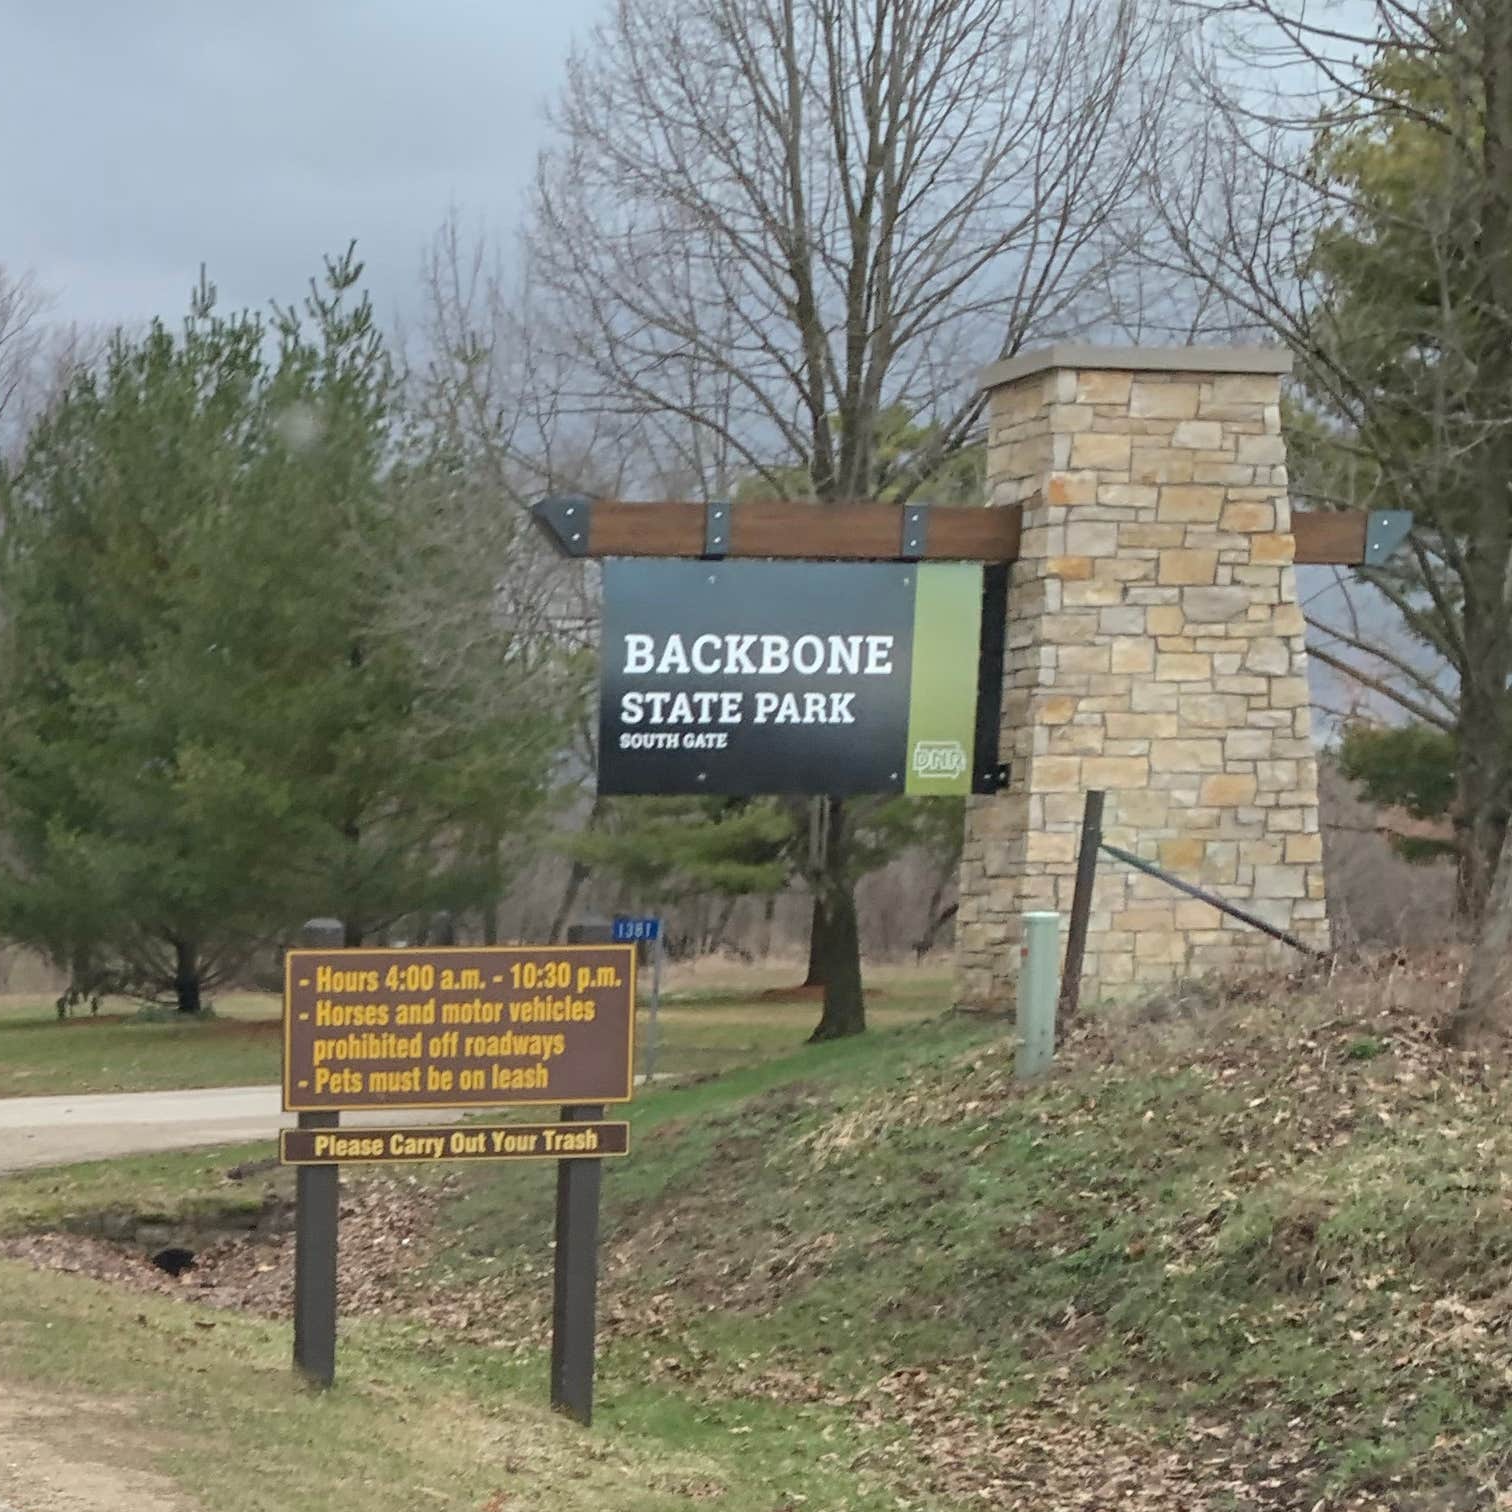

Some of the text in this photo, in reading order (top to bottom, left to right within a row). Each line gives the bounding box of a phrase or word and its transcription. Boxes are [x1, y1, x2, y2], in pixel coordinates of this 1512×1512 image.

[623, 633, 894, 676] BACKBONE
[620, 691, 856, 725] STATE PARK
[619, 732, 729, 750] SOUTH GATE
[315, 965, 380, 993] Hours
[384, 963, 436, 992] 4:00
[439, 968, 486, 991] a.m.
[509, 961, 572, 990] 10:30
[576, 965, 622, 994] p.m.
[315, 999, 390, 1027] Horses
[395, 998, 436, 1026] and
[441, 999, 503, 1026] motor
[508, 996, 596, 1024] vehicles
[312, 1030, 566, 1066] prohibited off roadways
[313, 1067, 364, 1095] Pets
[368, 1067, 421, 1093] must
[426, 1064, 454, 1091] be
[459, 1069, 486, 1091] on
[491, 1063, 550, 1090] leash
[314, 1129, 599, 1159] Please Carry Out Your Trash
